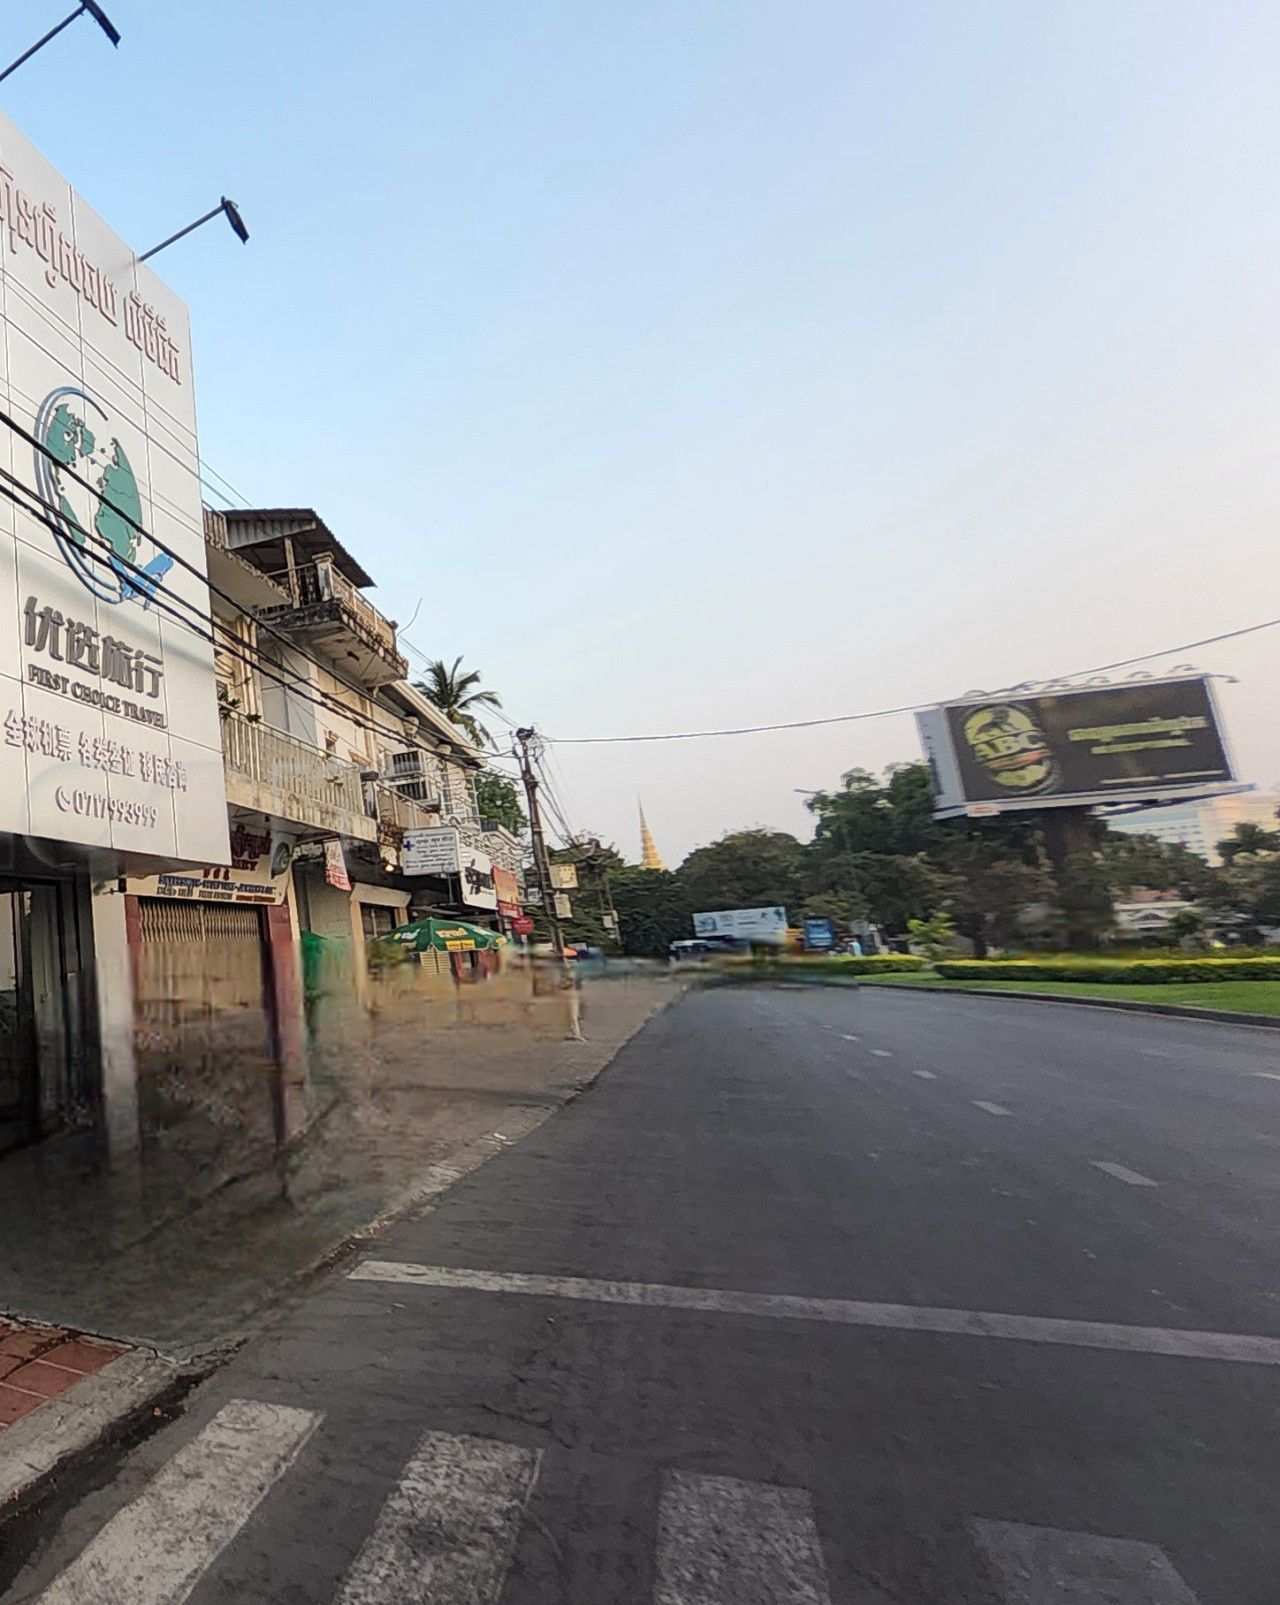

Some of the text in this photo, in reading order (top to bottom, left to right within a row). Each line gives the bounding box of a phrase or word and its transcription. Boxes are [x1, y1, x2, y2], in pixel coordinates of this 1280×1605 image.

[23, 595, 165, 699] 优选旅行
[27, 663, 169, 729] FIRST CHOICE TRAVEL
[973, 732, 1046, 762] ABC
